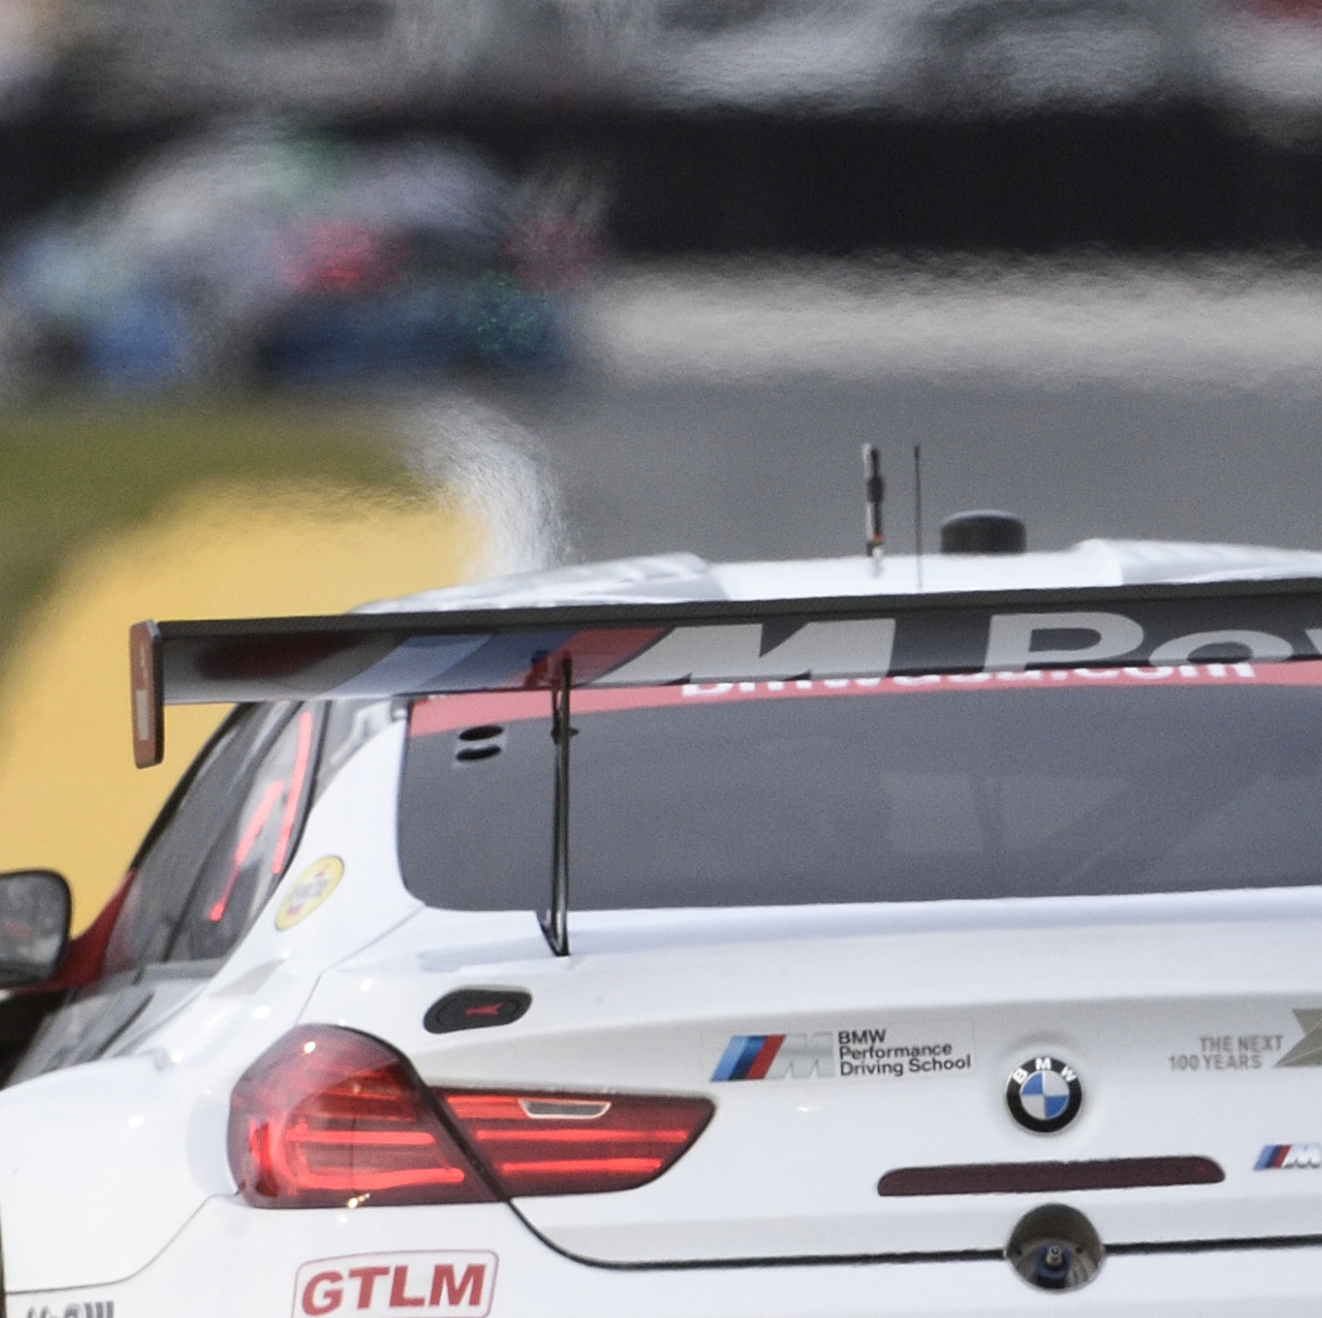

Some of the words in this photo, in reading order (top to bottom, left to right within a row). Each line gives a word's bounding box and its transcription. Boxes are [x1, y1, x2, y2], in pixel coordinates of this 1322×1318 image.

[838, 1029, 886, 1045] BMW
[1199, 1035, 1233, 1052] THE
[1237, 1034, 1284, 1052] NEXT
[839, 1043, 952, 1061] Performance
[840, 1058, 904, 1077] Driving
[908, 1055, 971, 1073] School
[1012, 1057, 1078, 1085] BMW
[1169, 1055, 1199, 1071] 100
[1202, 1054, 1262, 1071] YEARS
[301, 1263, 486, 1317] GTLM
